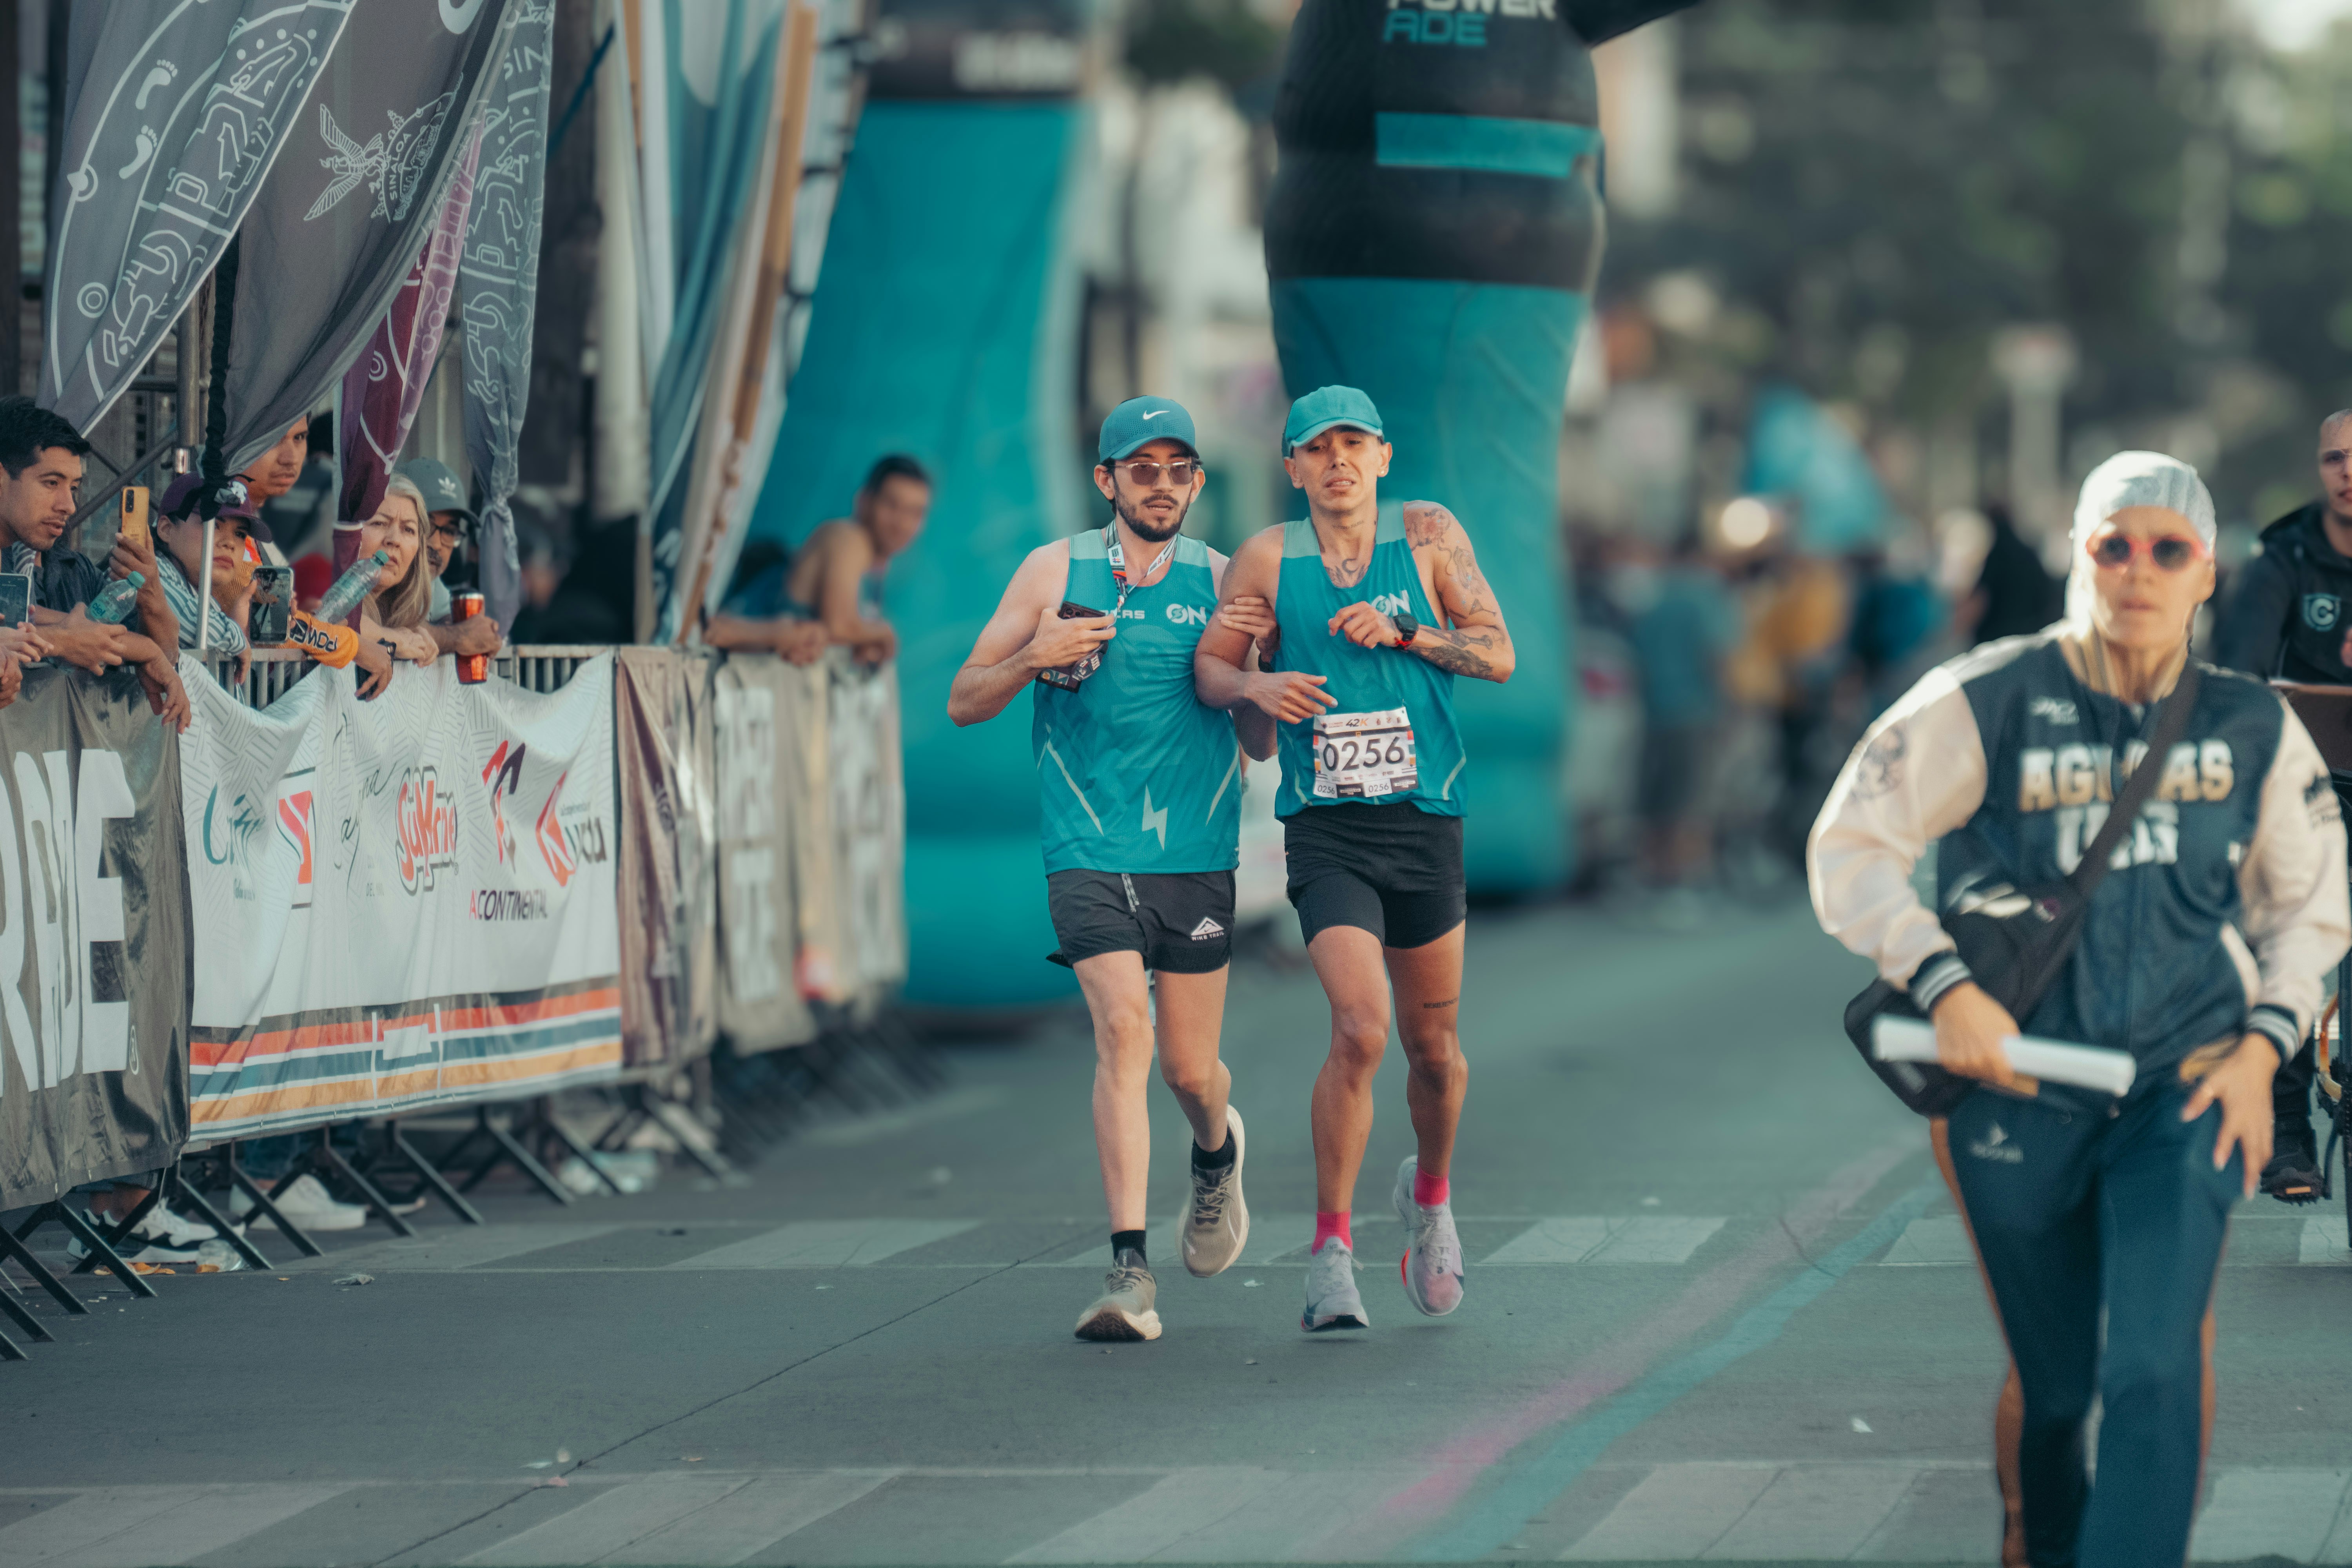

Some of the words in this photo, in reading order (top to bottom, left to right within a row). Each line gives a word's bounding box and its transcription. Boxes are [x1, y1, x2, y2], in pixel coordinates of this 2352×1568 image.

[1384, 10, 1486, 45] ADE
[389, 133, 412, 200] SINALOA
[1346, 718, 1369, 728] 42K
[1323, 736, 1405, 771] 0256
[1318, 785, 1335, 795] 0256
[1368, 783, 1389, 793] 0256
